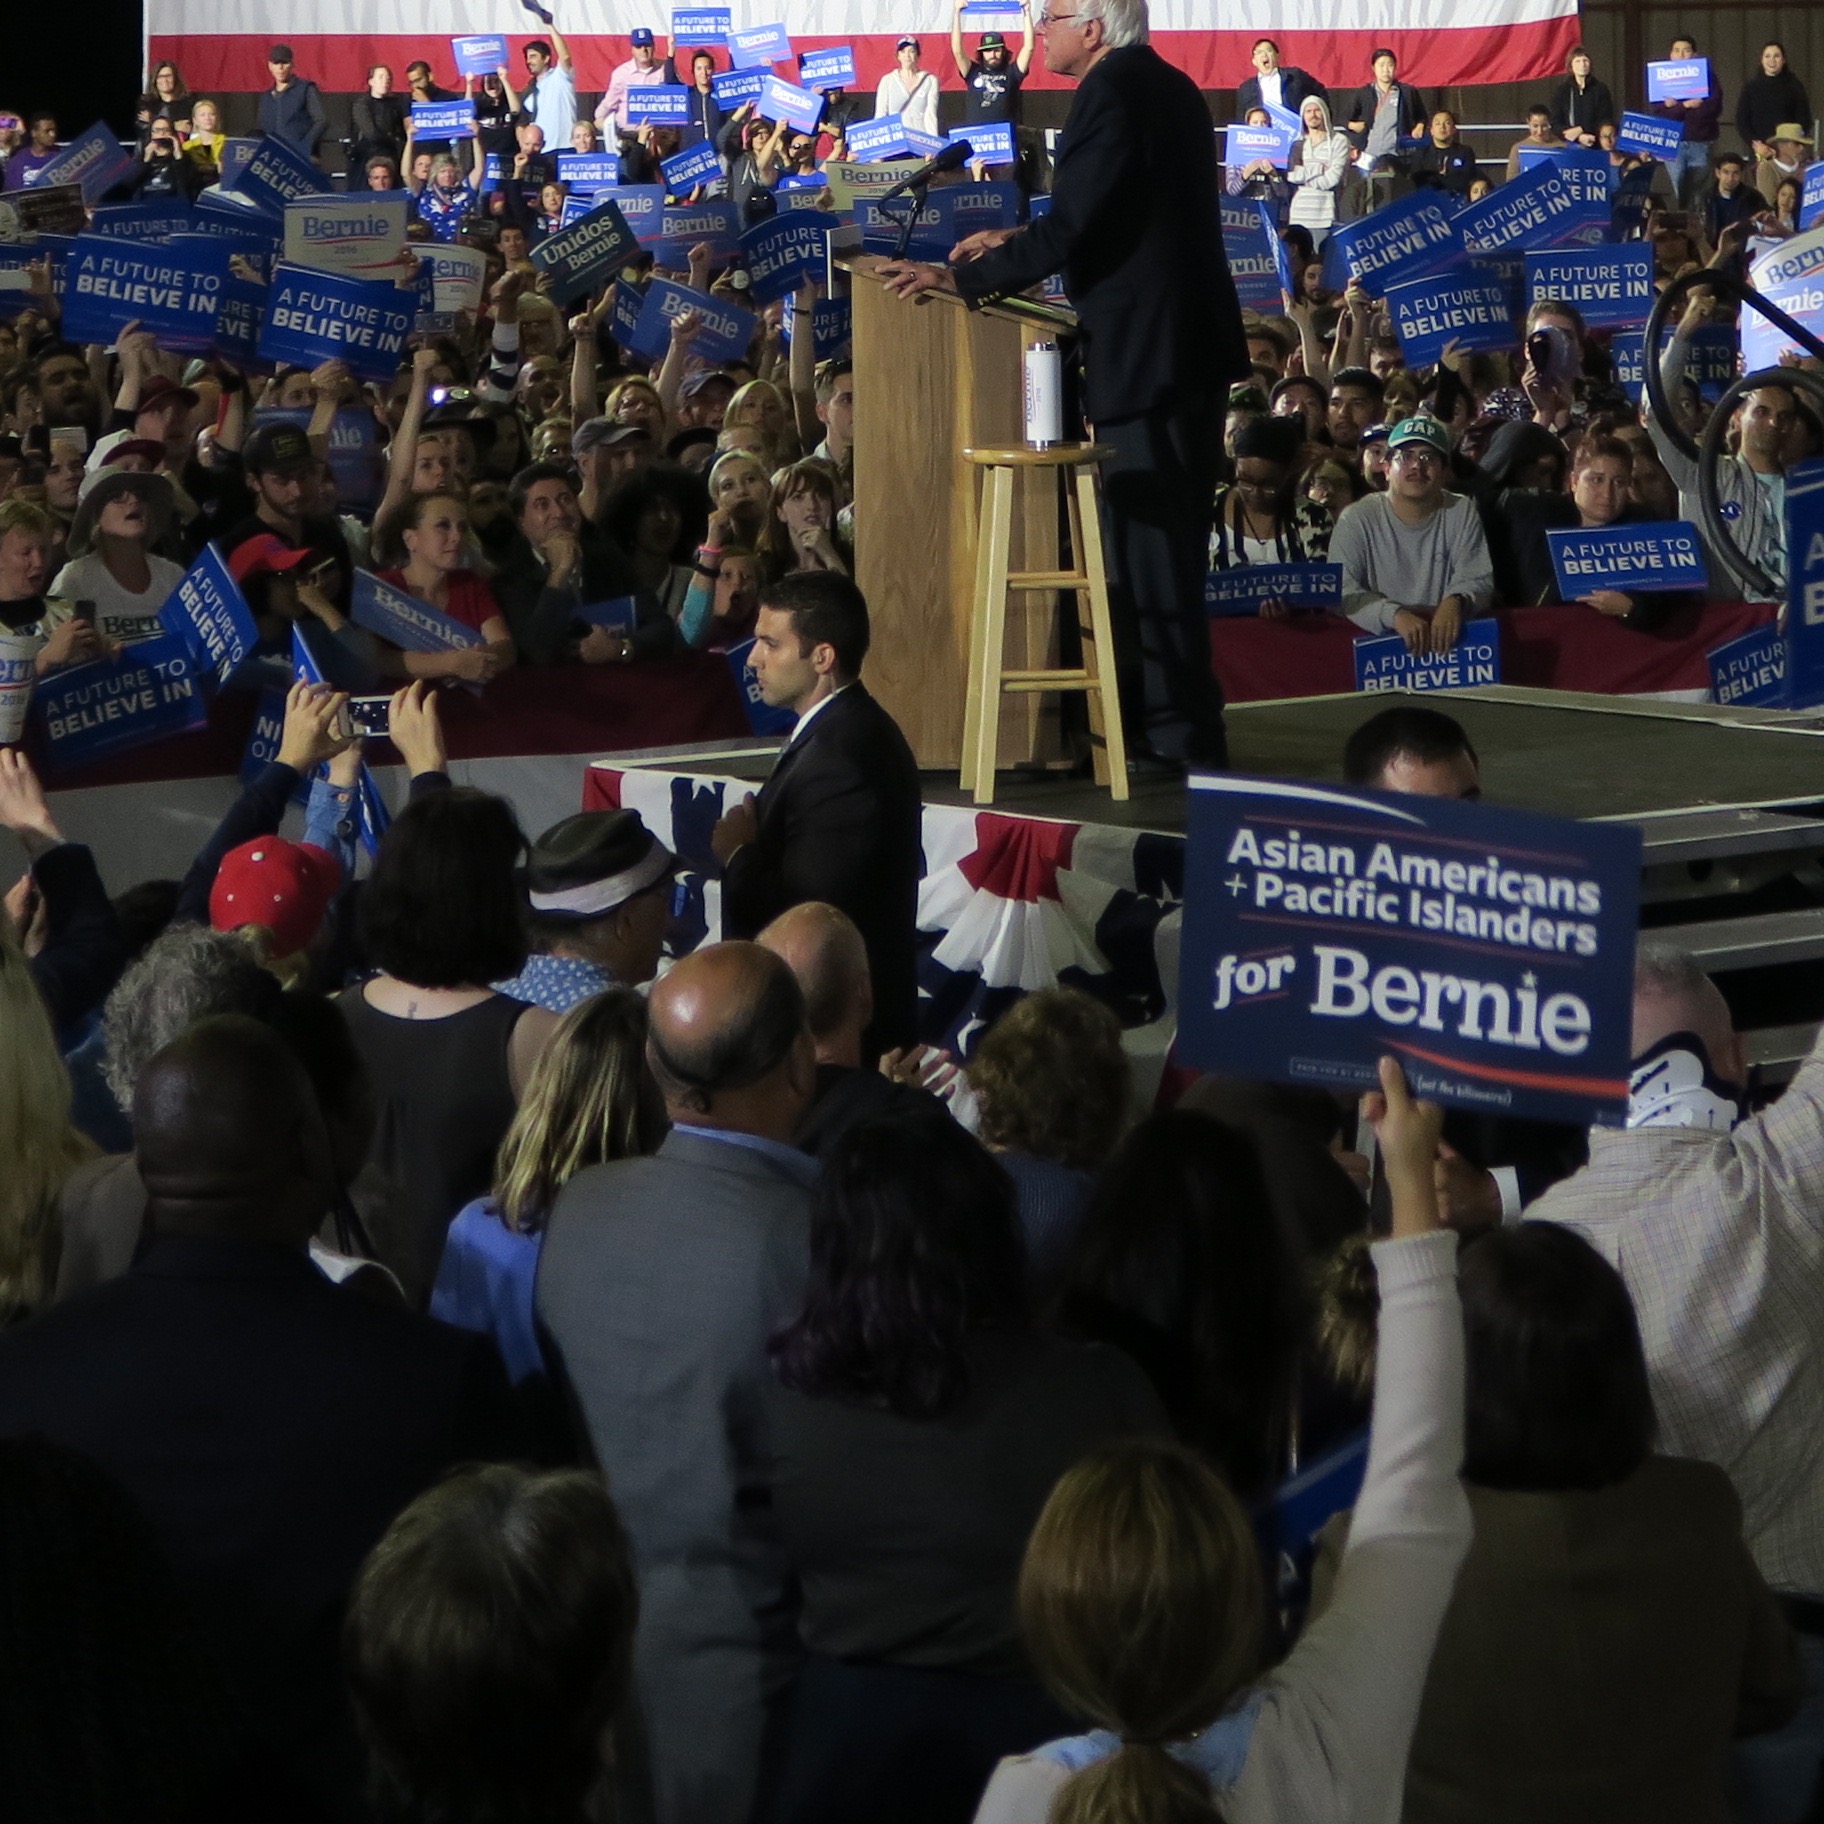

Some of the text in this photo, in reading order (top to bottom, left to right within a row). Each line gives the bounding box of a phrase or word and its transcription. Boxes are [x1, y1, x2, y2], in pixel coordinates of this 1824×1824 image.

[462, 39, 501, 55] Bernie
[736, 30, 779, 48] Bernie
[1656, 64, 1700, 78] Bernie
[628, 103, 686, 112] BELIEVE IN
[1236, 129, 1281, 146] Bernie
[49, 137, 106, 184] Bernie
[1586, 168, 1606, 183] TO
[1463, 179, 1562, 242] A FUTURE TO
[1586, 186, 1606, 201] IN
[302, 216, 388, 238] Bernie
[542, 214, 614, 266] Unidos
[662, 214, 726, 236] Bernie
[1466, 192, 1572, 252] BELIEVE IN
[566, 230, 621, 272] Bernie
[747, 227, 819, 263] A FUTURE
[750, 243, 824, 282] BELIEVE
[1349, 221, 1452, 278] BELIEVE IN
[80, 254, 221, 292] A FUTURE TO
[1533, 263, 1649, 282] A FUTURE TO
[76, 274, 217, 315] BELIEVE IN
[279, 288, 408, 330] A FUTURE TO
[1399, 287, 1502, 320] A FUTURE TO
[1533, 280, 1649, 302] BELIEVE IN
[272, 308, 402, 353] BELIEVE IN
[1402, 304, 1508, 340] BELIEVE IN
[1403, 424, 1437, 437] GAP
[1562, 537, 1691, 560] A FUTURE TO
[1564, 551, 1697, 576] BELIEVE IN
[1204, 582, 1337, 602] BELIEVE IN
[375, 584, 469, 650] Bernie
[1364, 657, 1376, 675] A
[1464, 644, 1493, 663] TO
[1364, 664, 1494, 691] BELIEVE IN
[46, 657, 188, 717] A FUTURE TO
[48, 681, 193, 740] BELIEVE IN
[1227, 827, 1602, 916] Asian Americans
[1255, 872, 1401, 924] Pacific
[1409, 892, 1598, 957] Islanders
[1213, 943, 1591, 1057] for Bernie
